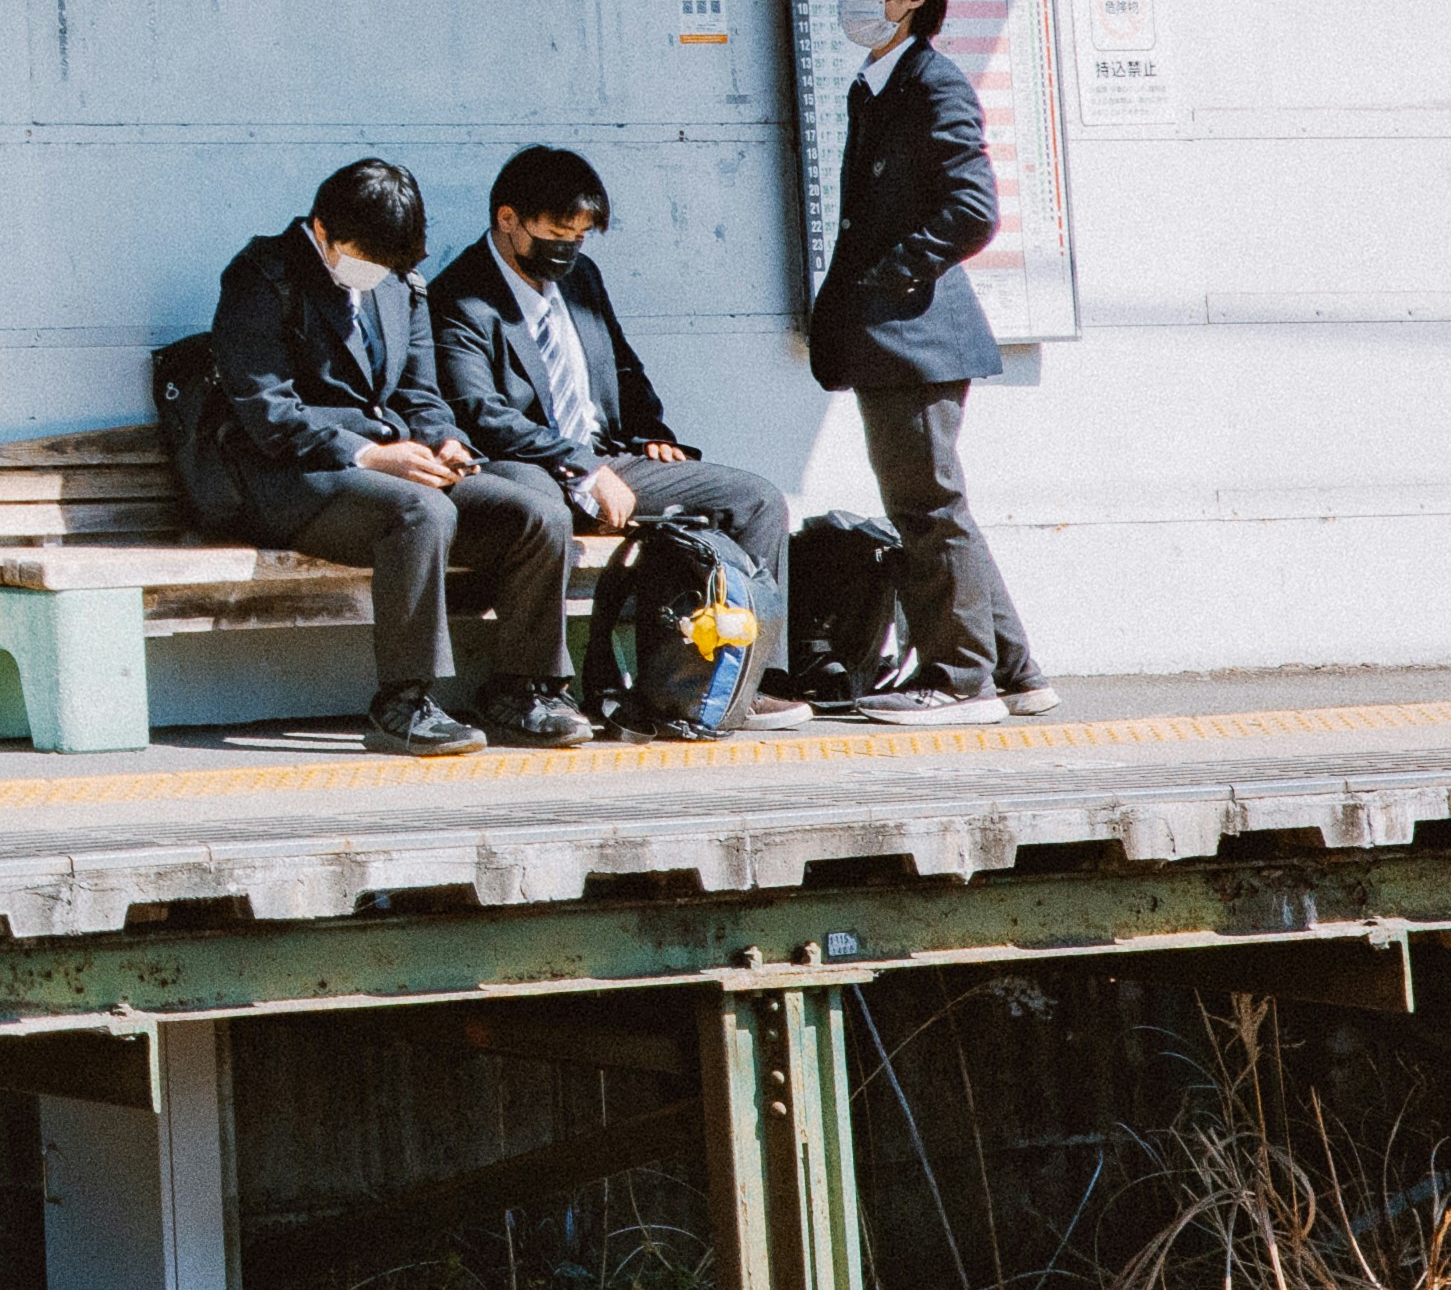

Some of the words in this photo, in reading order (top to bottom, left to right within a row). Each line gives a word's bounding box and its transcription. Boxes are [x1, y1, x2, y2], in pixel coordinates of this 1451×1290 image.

[797, 3, 808, 15] 10
[798, 21, 808, 33] 11
[799, 39, 810, 51] 12
[801, 57, 811, 69] 13
[1096, 61, 1157, 78] 持込禁止
[802, 76, 813, 87] 14
[803, 93, 814, 105] 15
[804, 111, 816, 123] 16
[805, 129, 816, 141] 17
[807, 148, 818, 160] 18
[808, 166, 819, 178] 19
[809, 184, 820, 196] 20
[810, 203, 820, 214] 21
[811, 221, 822, 232] 22
[812, 239, 823, 251] 23
[815, 257, 822, 269] 0
